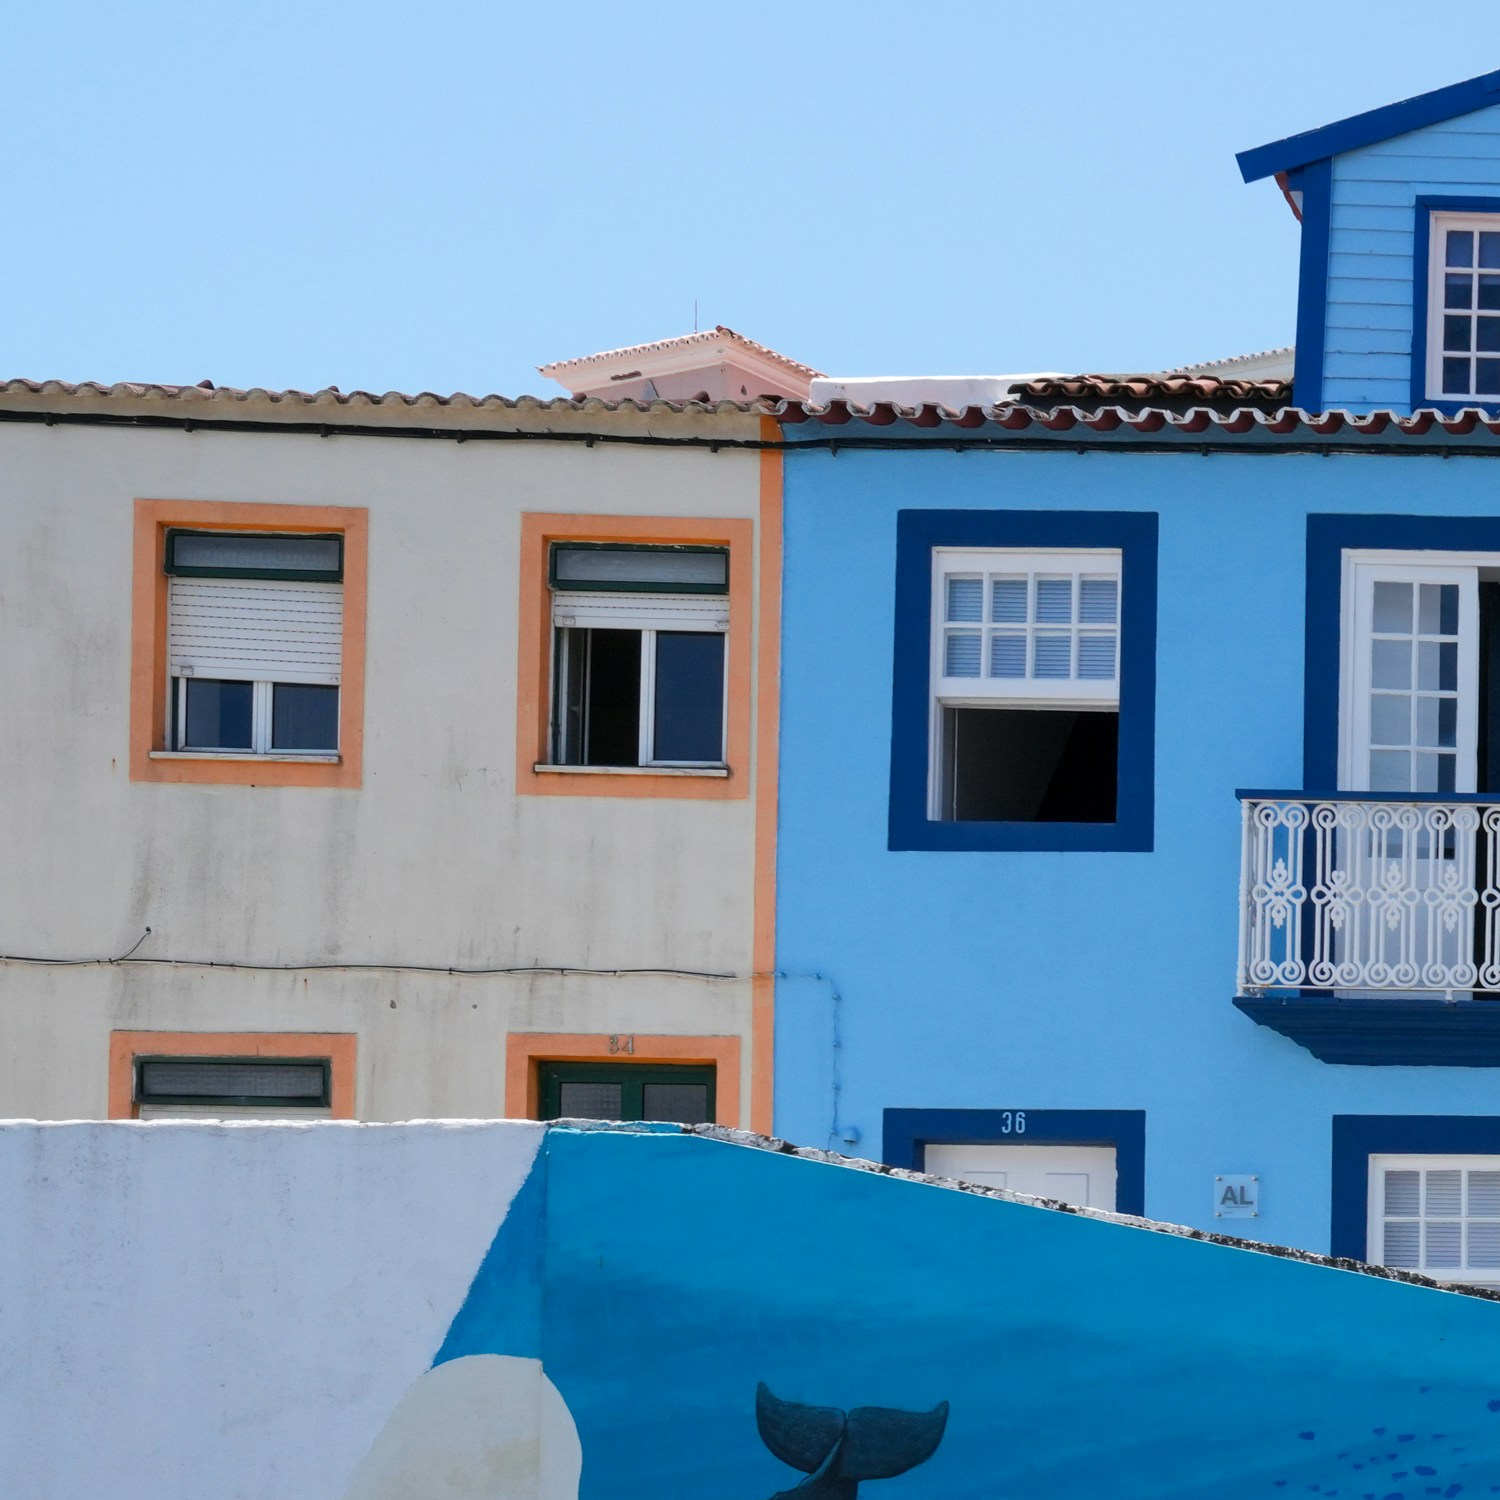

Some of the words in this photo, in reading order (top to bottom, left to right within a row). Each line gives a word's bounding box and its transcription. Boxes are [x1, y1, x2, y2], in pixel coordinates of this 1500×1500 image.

[607, 1034, 635, 1055] 34
[1001, 1111, 1026, 1134] 36
[1220, 1185, 1254, 1205] AL
